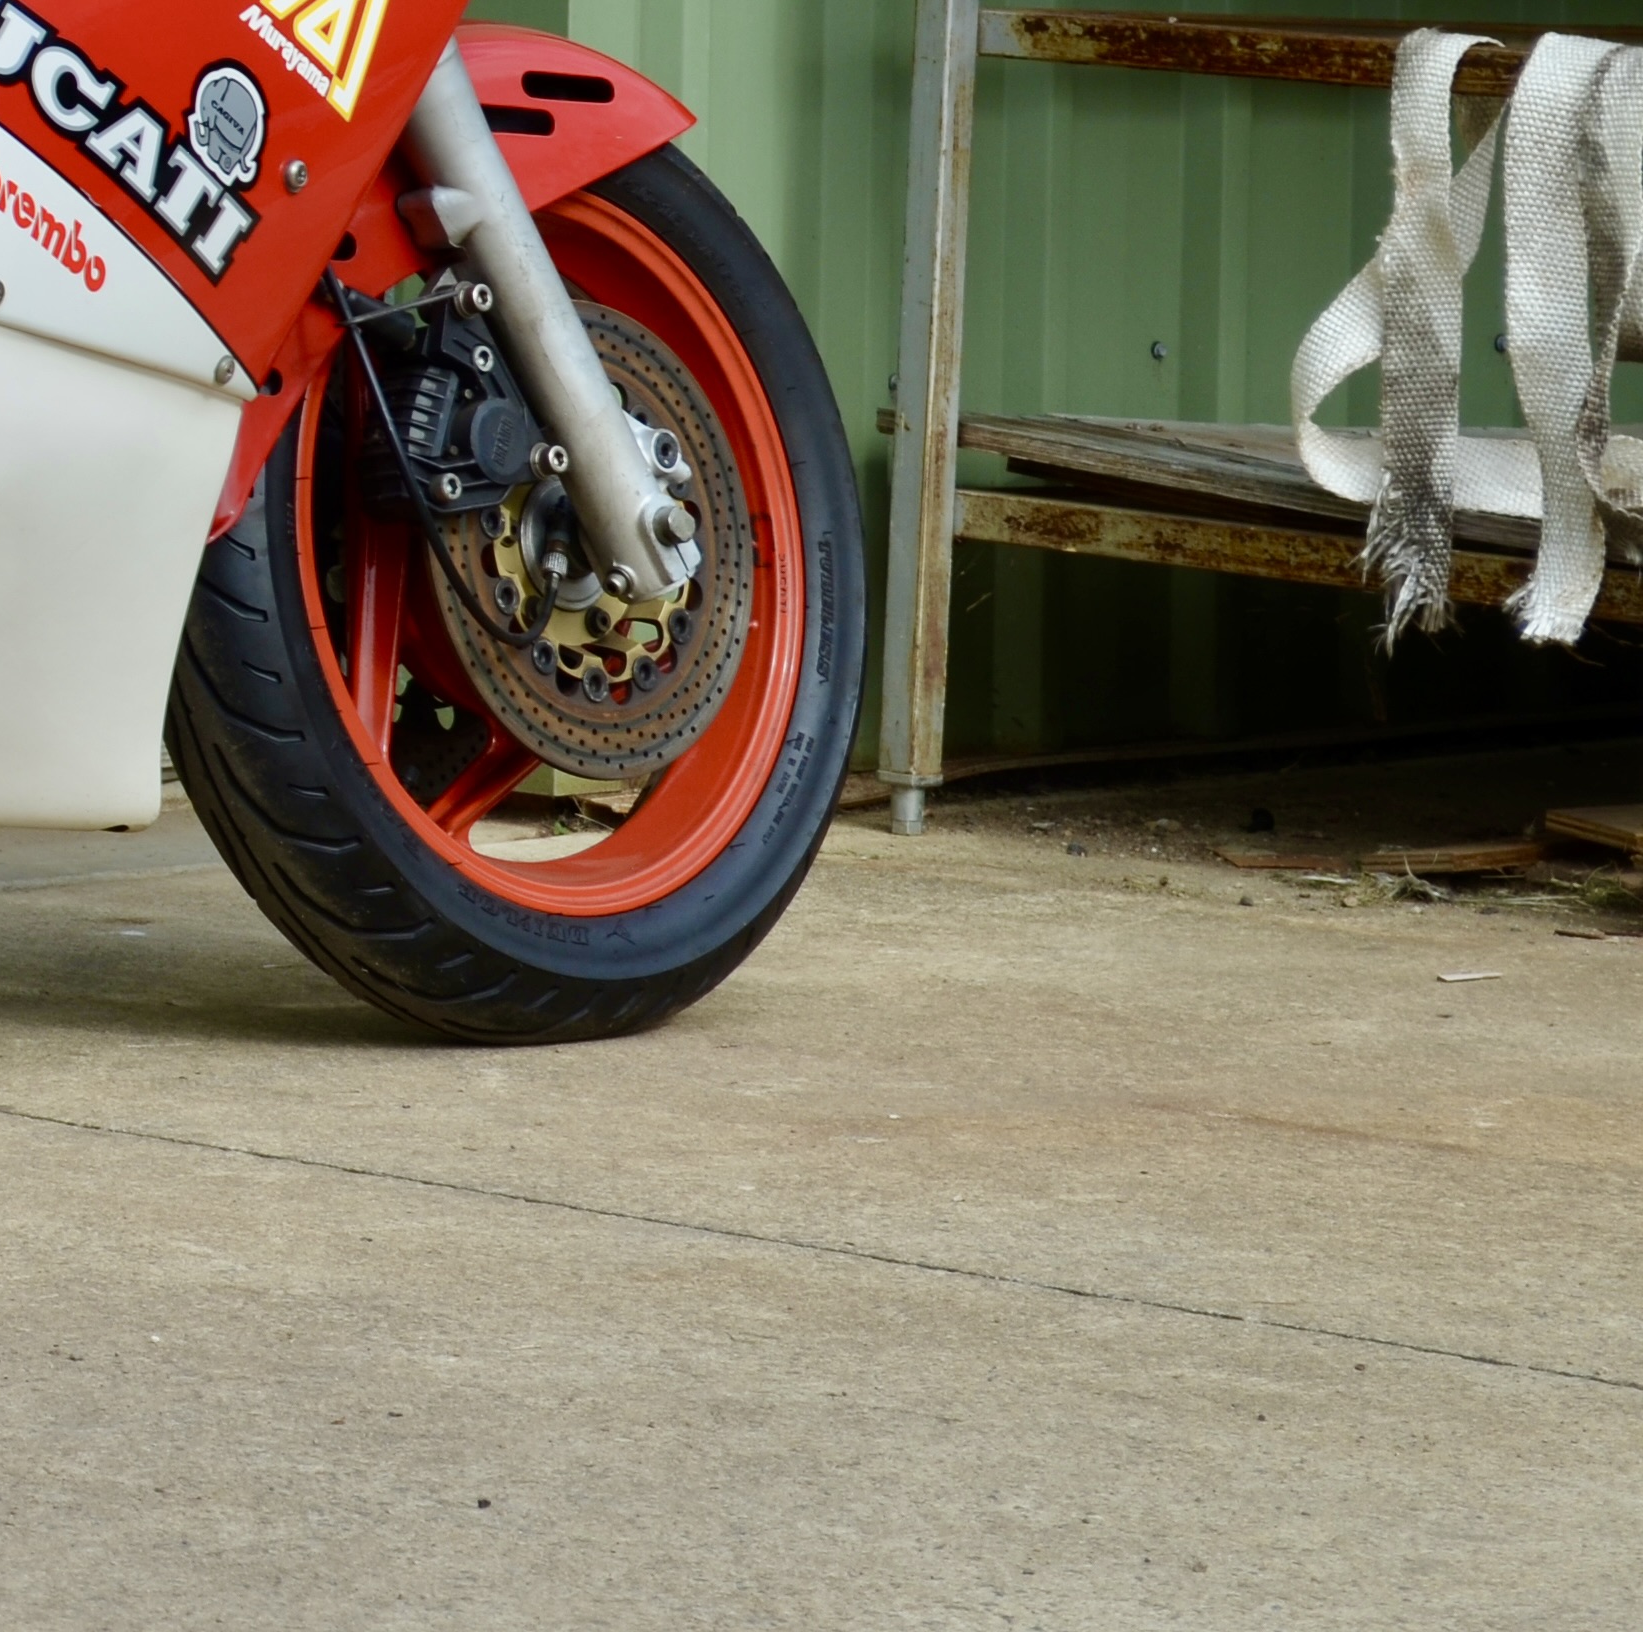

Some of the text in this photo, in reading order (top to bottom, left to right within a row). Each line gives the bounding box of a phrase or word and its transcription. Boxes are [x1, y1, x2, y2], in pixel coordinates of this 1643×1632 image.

[239, 4, 330, 97] Murayama
[211, 100, 245, 135] CAGIVA
[816, 540, 834, 679] TUBELESS
